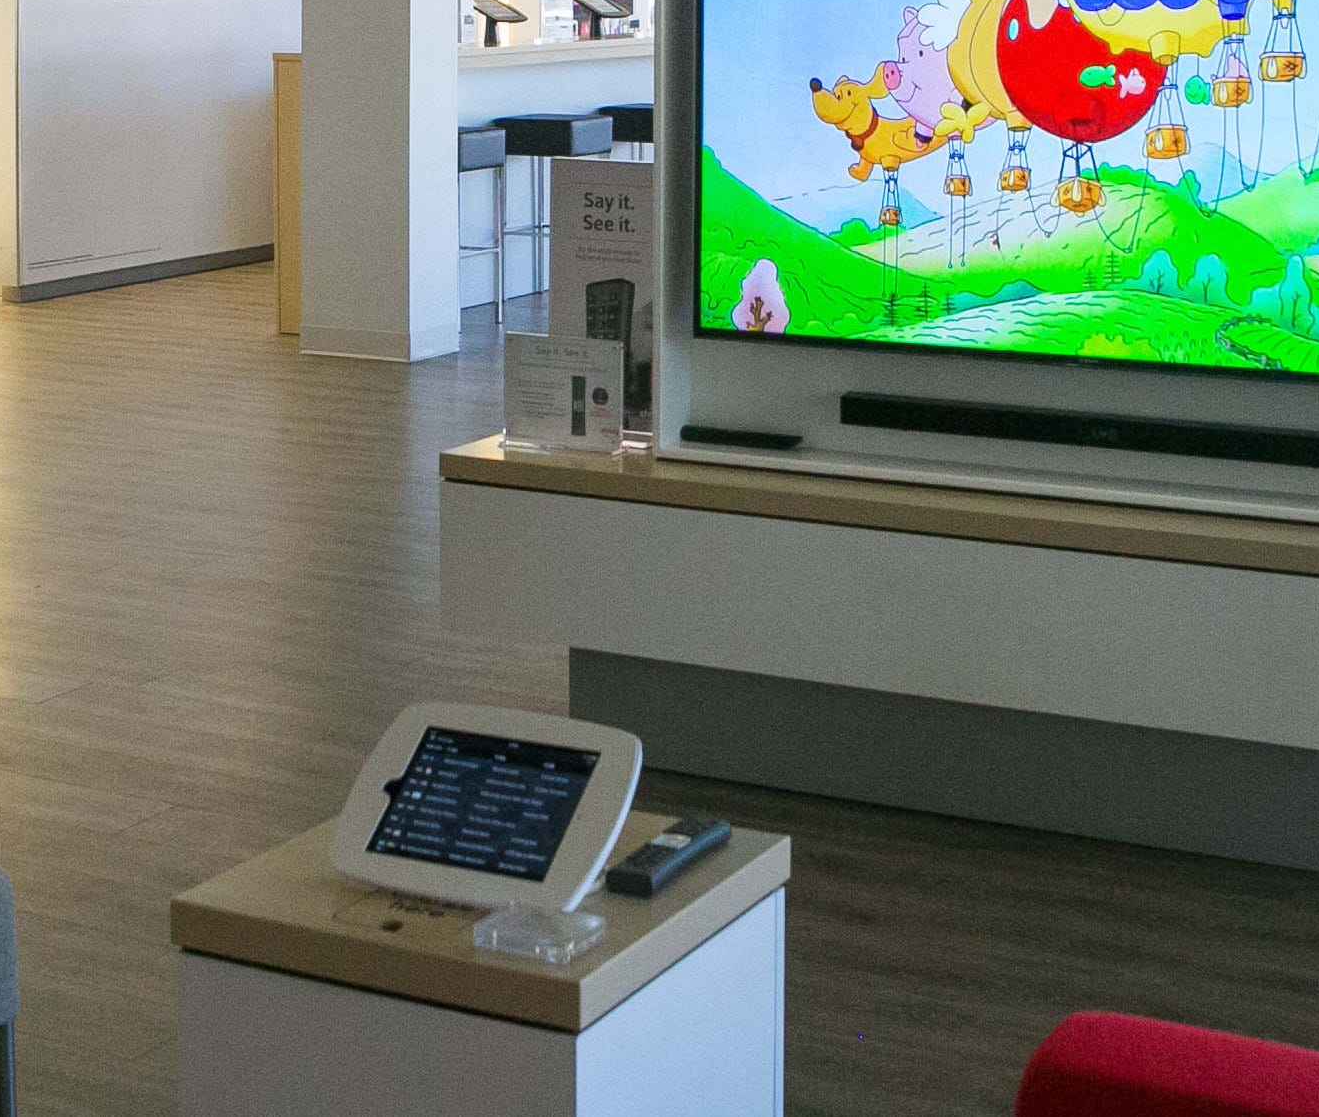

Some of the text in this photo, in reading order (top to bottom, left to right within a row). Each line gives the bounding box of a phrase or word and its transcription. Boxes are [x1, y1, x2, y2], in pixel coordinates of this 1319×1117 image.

[584, 191, 635, 213] Say it.
[583, 214, 635, 233] See it.
